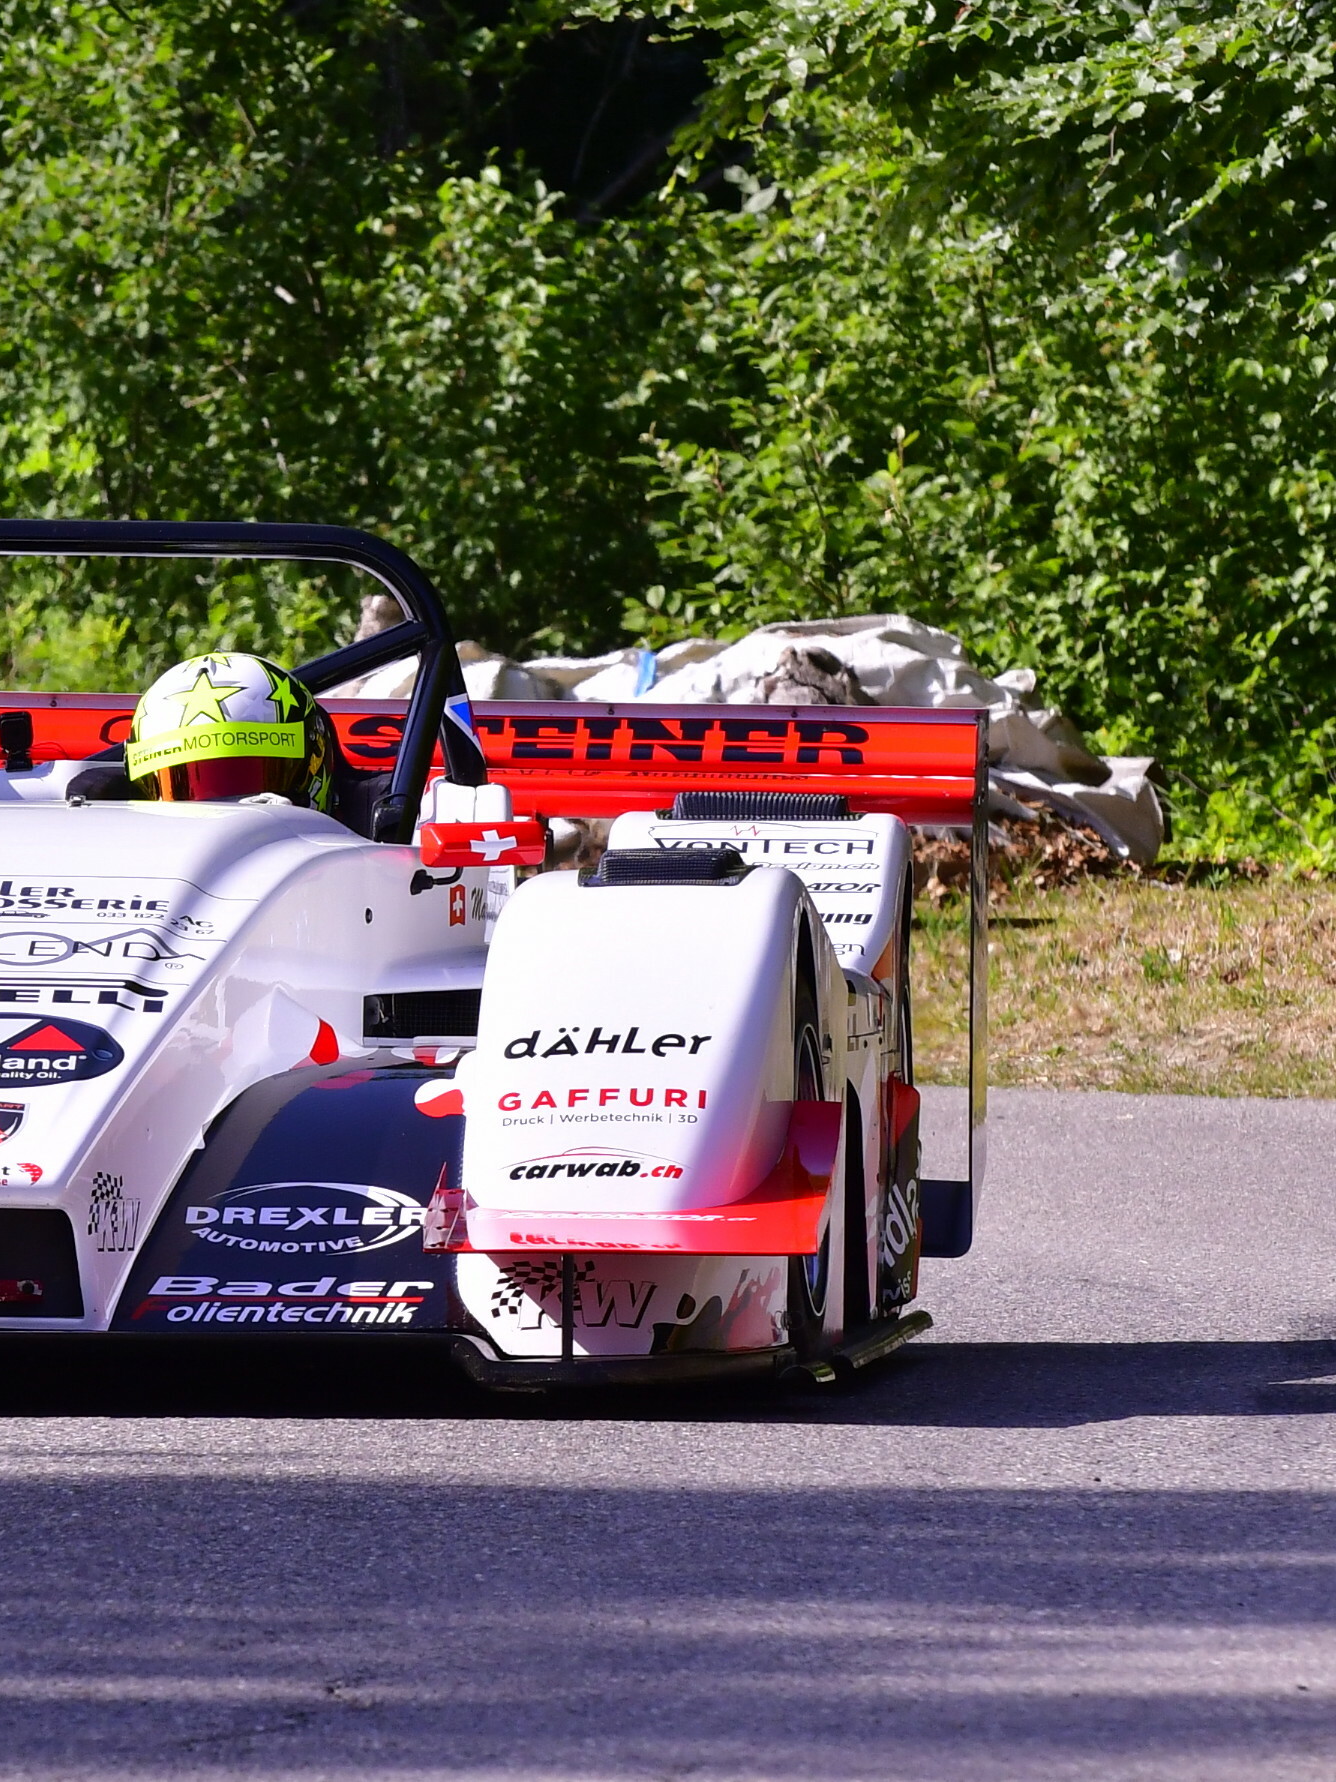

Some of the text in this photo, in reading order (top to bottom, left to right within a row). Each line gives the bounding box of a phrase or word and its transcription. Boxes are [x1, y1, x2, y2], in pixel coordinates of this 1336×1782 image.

[184, 731, 295, 750] MOTORSPORT
[654, 837, 874, 855] VONTECH
[497, 1088, 706, 1111] GAFFURI
[502, 1112, 698, 1126] Druck Werbetechnik 3D
[509, 1159, 683, 1180] carwab.ch
[184, 1205, 427, 1230] DREXLER
[193, 1225, 364, 1252] AUTOMOTIVE
[147, 1275, 435, 1298] Bader
